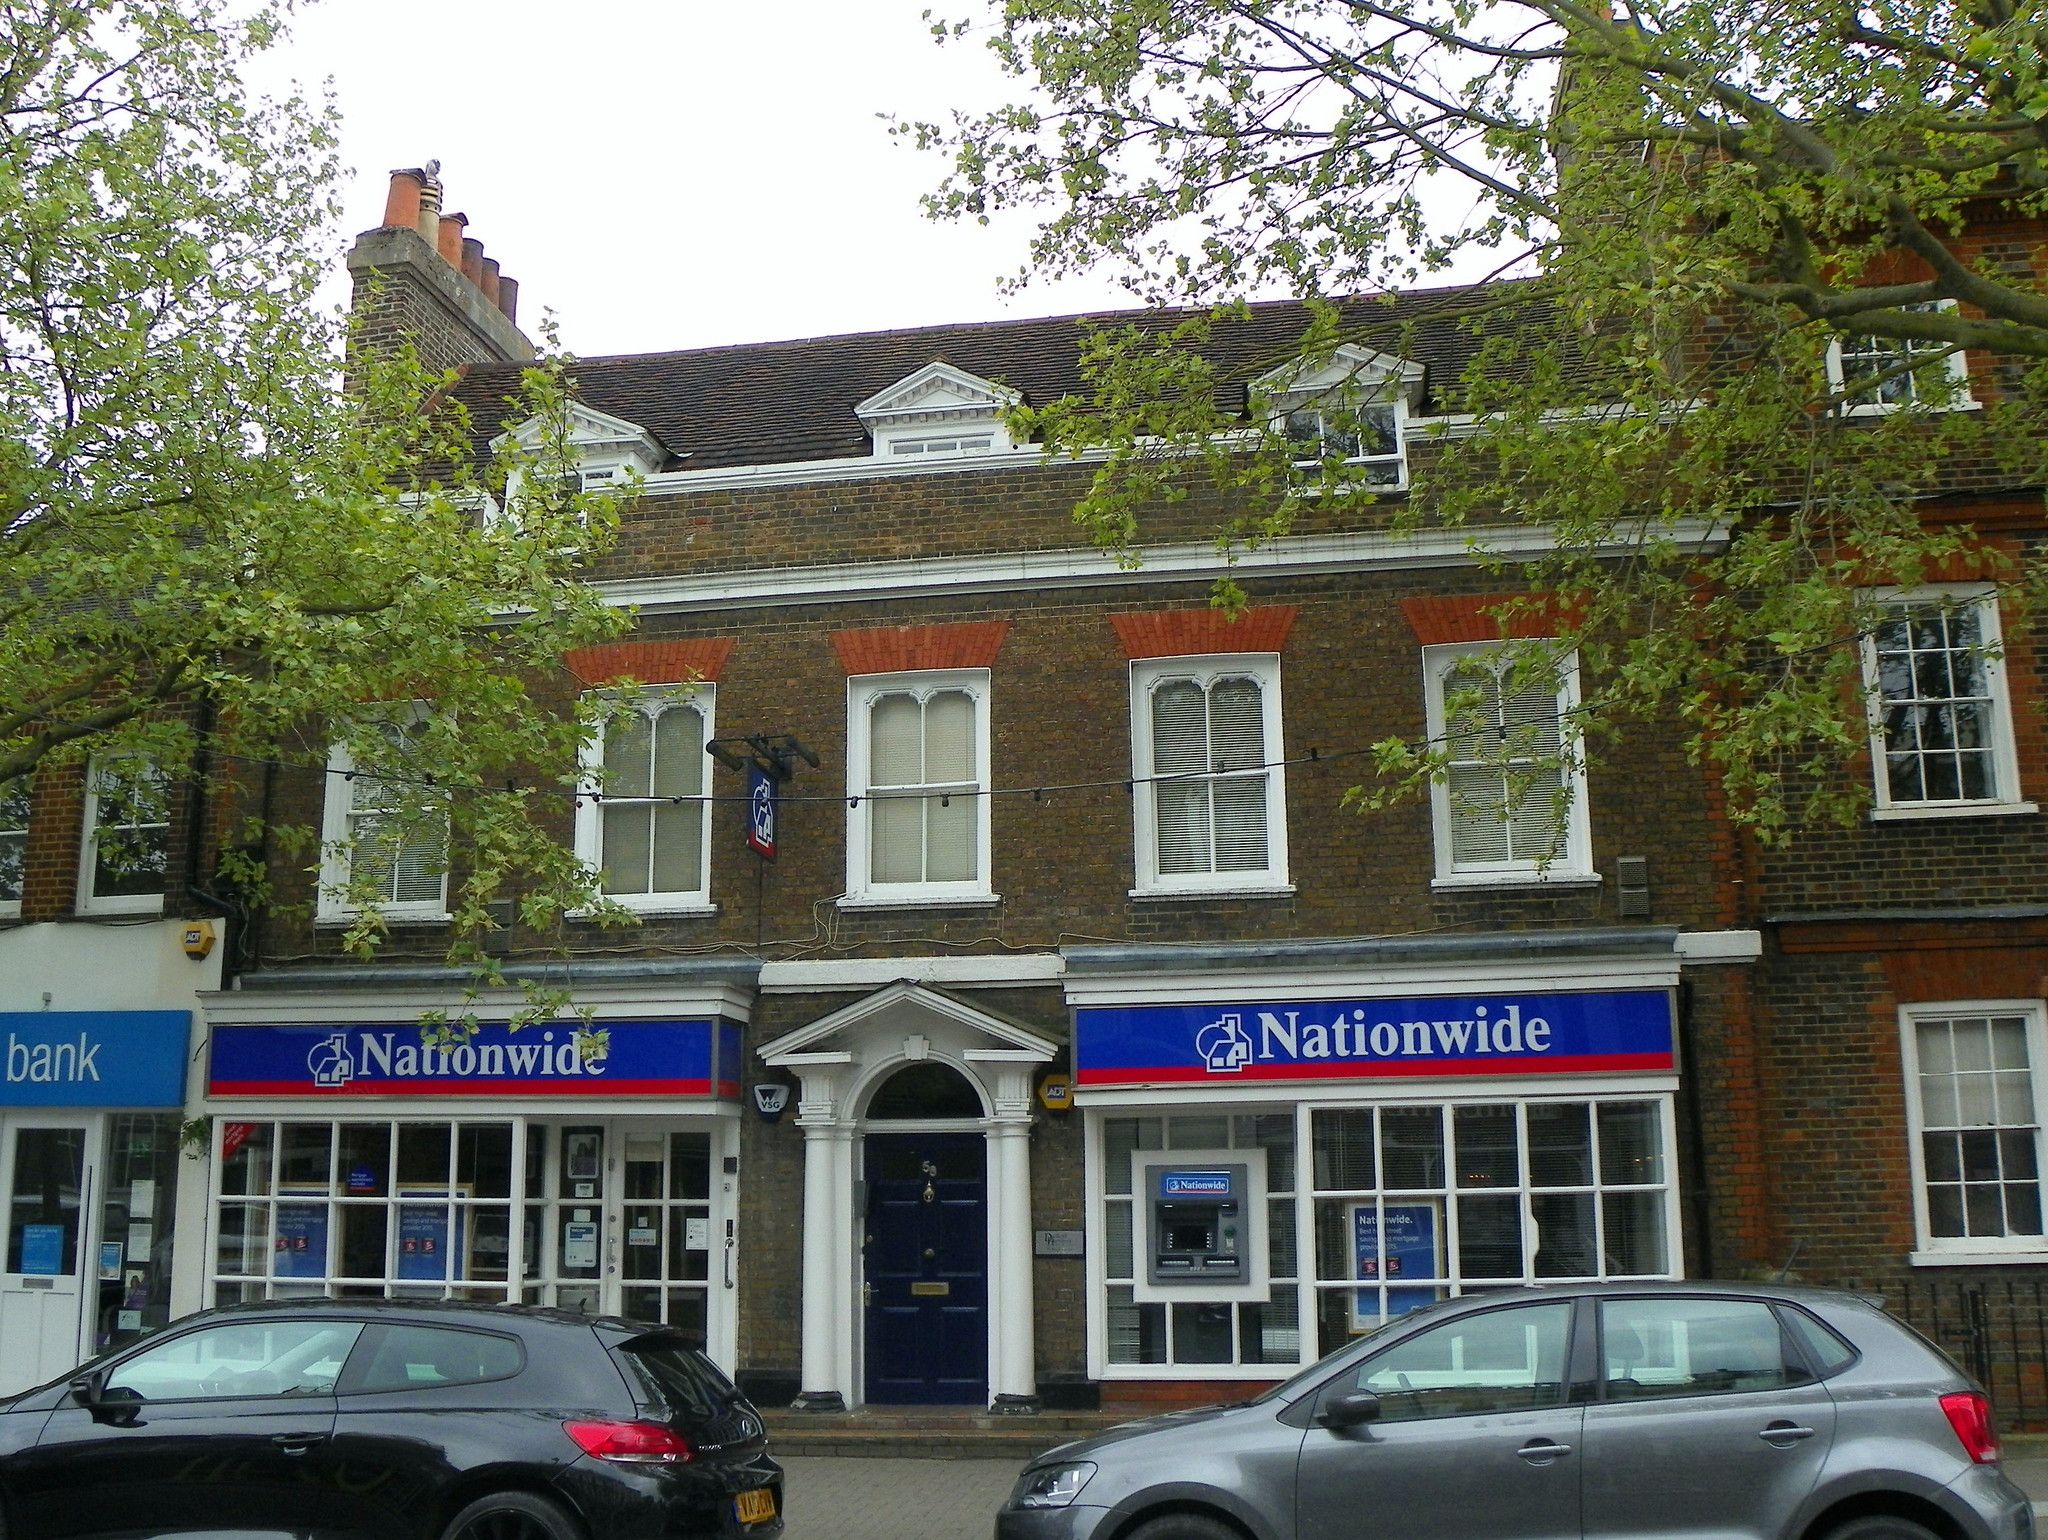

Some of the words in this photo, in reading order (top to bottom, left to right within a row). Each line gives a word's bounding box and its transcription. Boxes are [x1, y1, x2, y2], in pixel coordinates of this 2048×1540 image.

[1257, 1005, 1551, 1059] Nationwide
[7, 1032, 101, 1082] bank
[1048, 1087, 1066, 1097] ADT
[761, 1101, 780, 1109] VSG
[1180, 1181, 1226, 1190] Nationwide
[1360, 1215, 1413, 1225] Natnwide.
